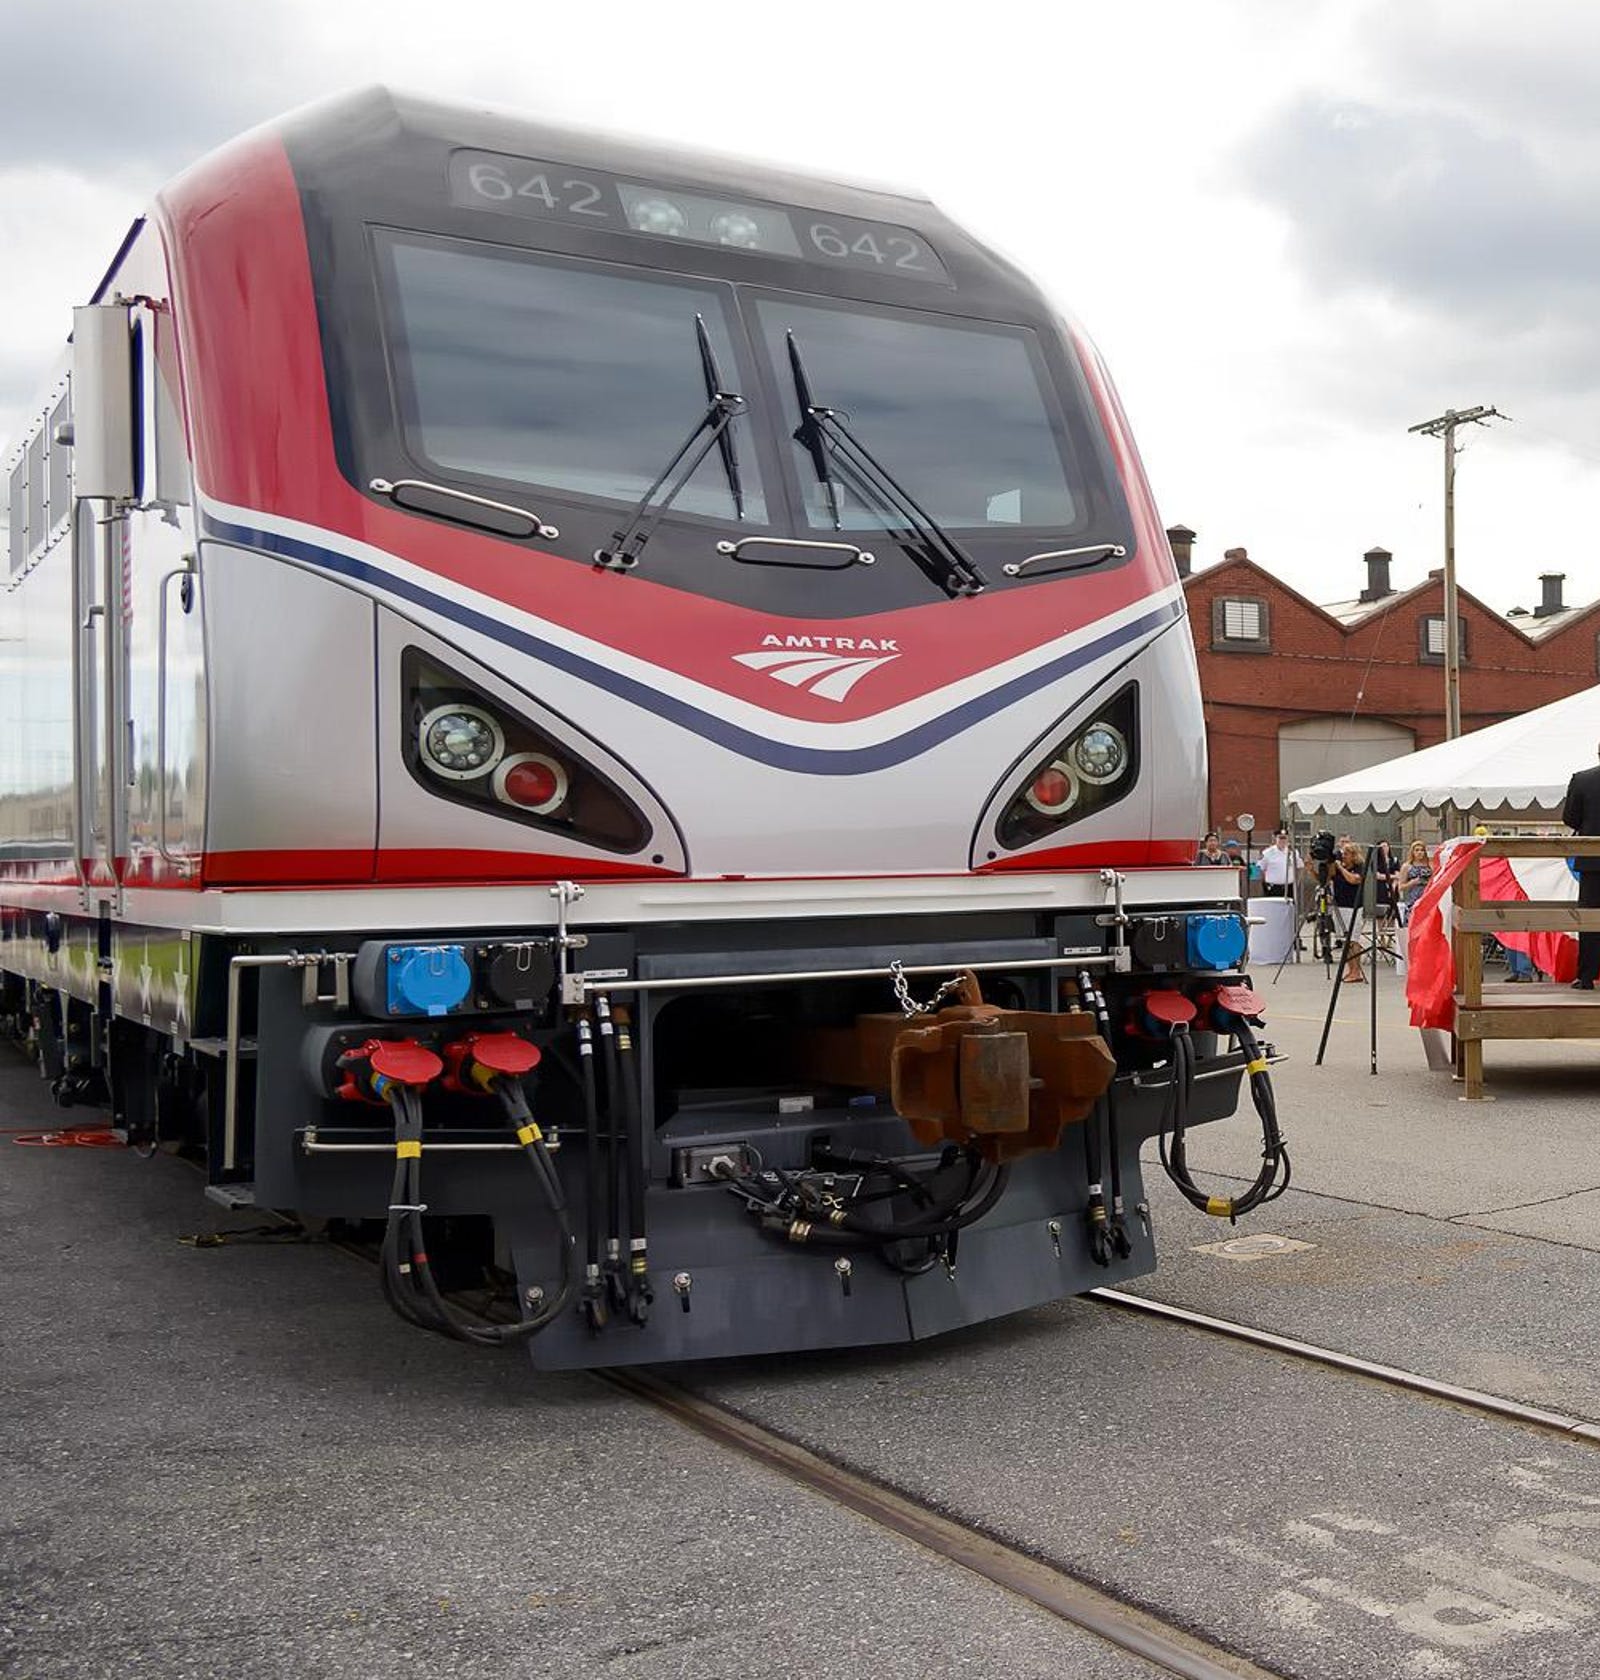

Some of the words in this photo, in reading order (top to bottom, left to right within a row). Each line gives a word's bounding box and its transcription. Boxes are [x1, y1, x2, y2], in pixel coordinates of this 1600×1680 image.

[468, 163, 608, 218] 642
[809, 223, 927, 270] 642
[762, 634, 899, 651] AMTRAK
